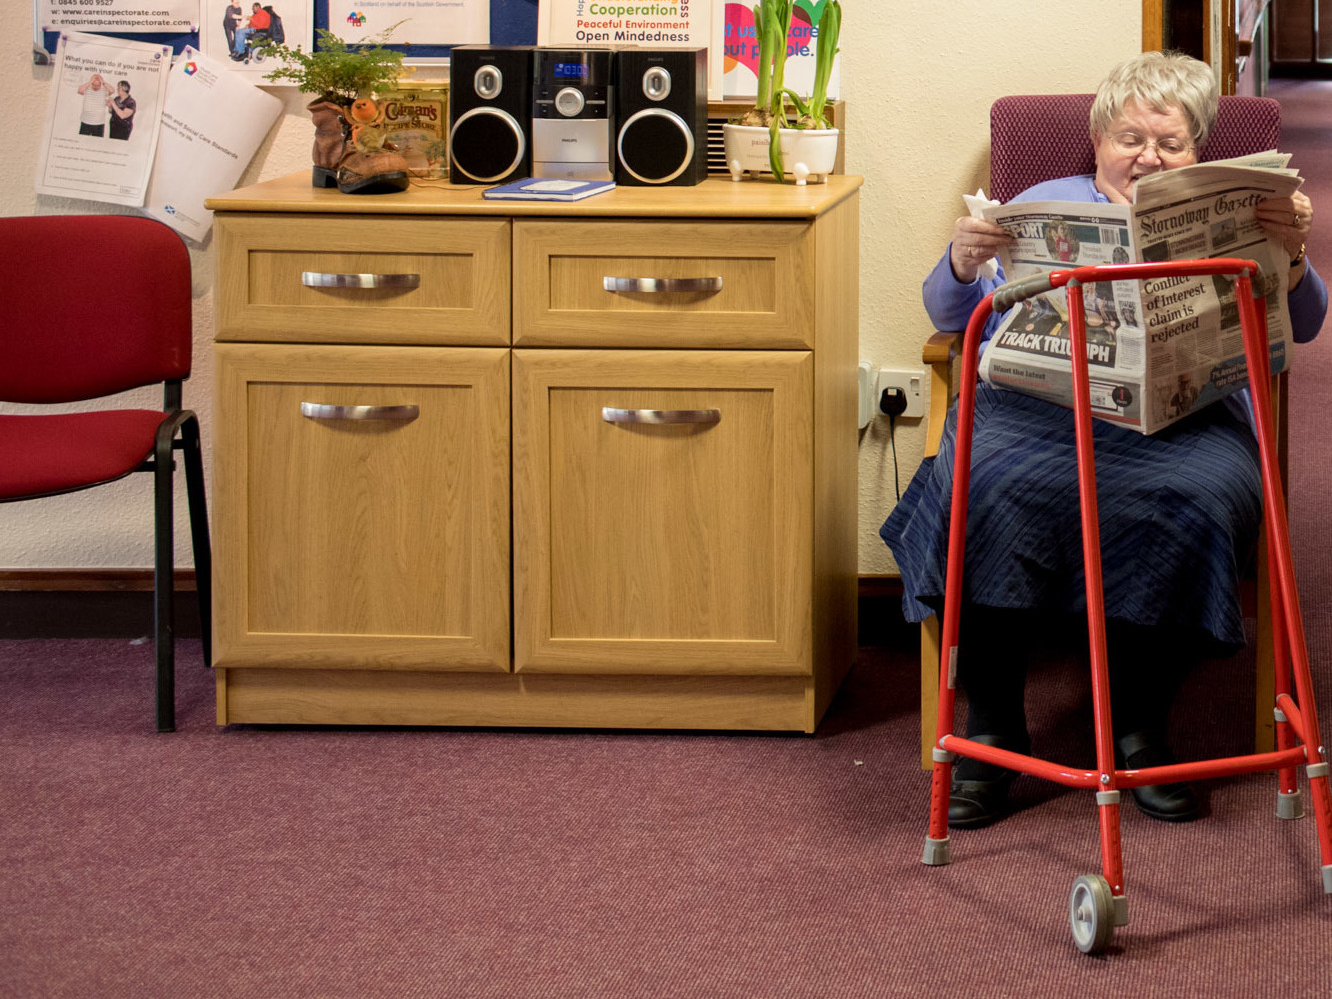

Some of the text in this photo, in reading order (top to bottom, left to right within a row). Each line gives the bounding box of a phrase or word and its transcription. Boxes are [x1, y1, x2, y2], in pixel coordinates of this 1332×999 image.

[63, 9, 169, 17] www.careinspectorate.com
[590, 4, 677, 17] Cooperation
[61, 19, 191, 27] enquiries@careinspectorate.com
[577, 19, 689, 29] Peaceful Environment
[576, 31, 689, 42] Open Mindedness
[64, 63, 82, 71] happy
[173, 118, 239, 159] and Social Care Standards
[1140, 193, 1267, 241] Stornoway Gazette
[1144, 275, 1190, 294] Conflict
[1147, 284, 1206, 311] of Interest
[1150, 305, 1194, 327] claim is
[1151, 318, 1199, 343] rejected
[1001, 332, 1043, 350] TRACK
